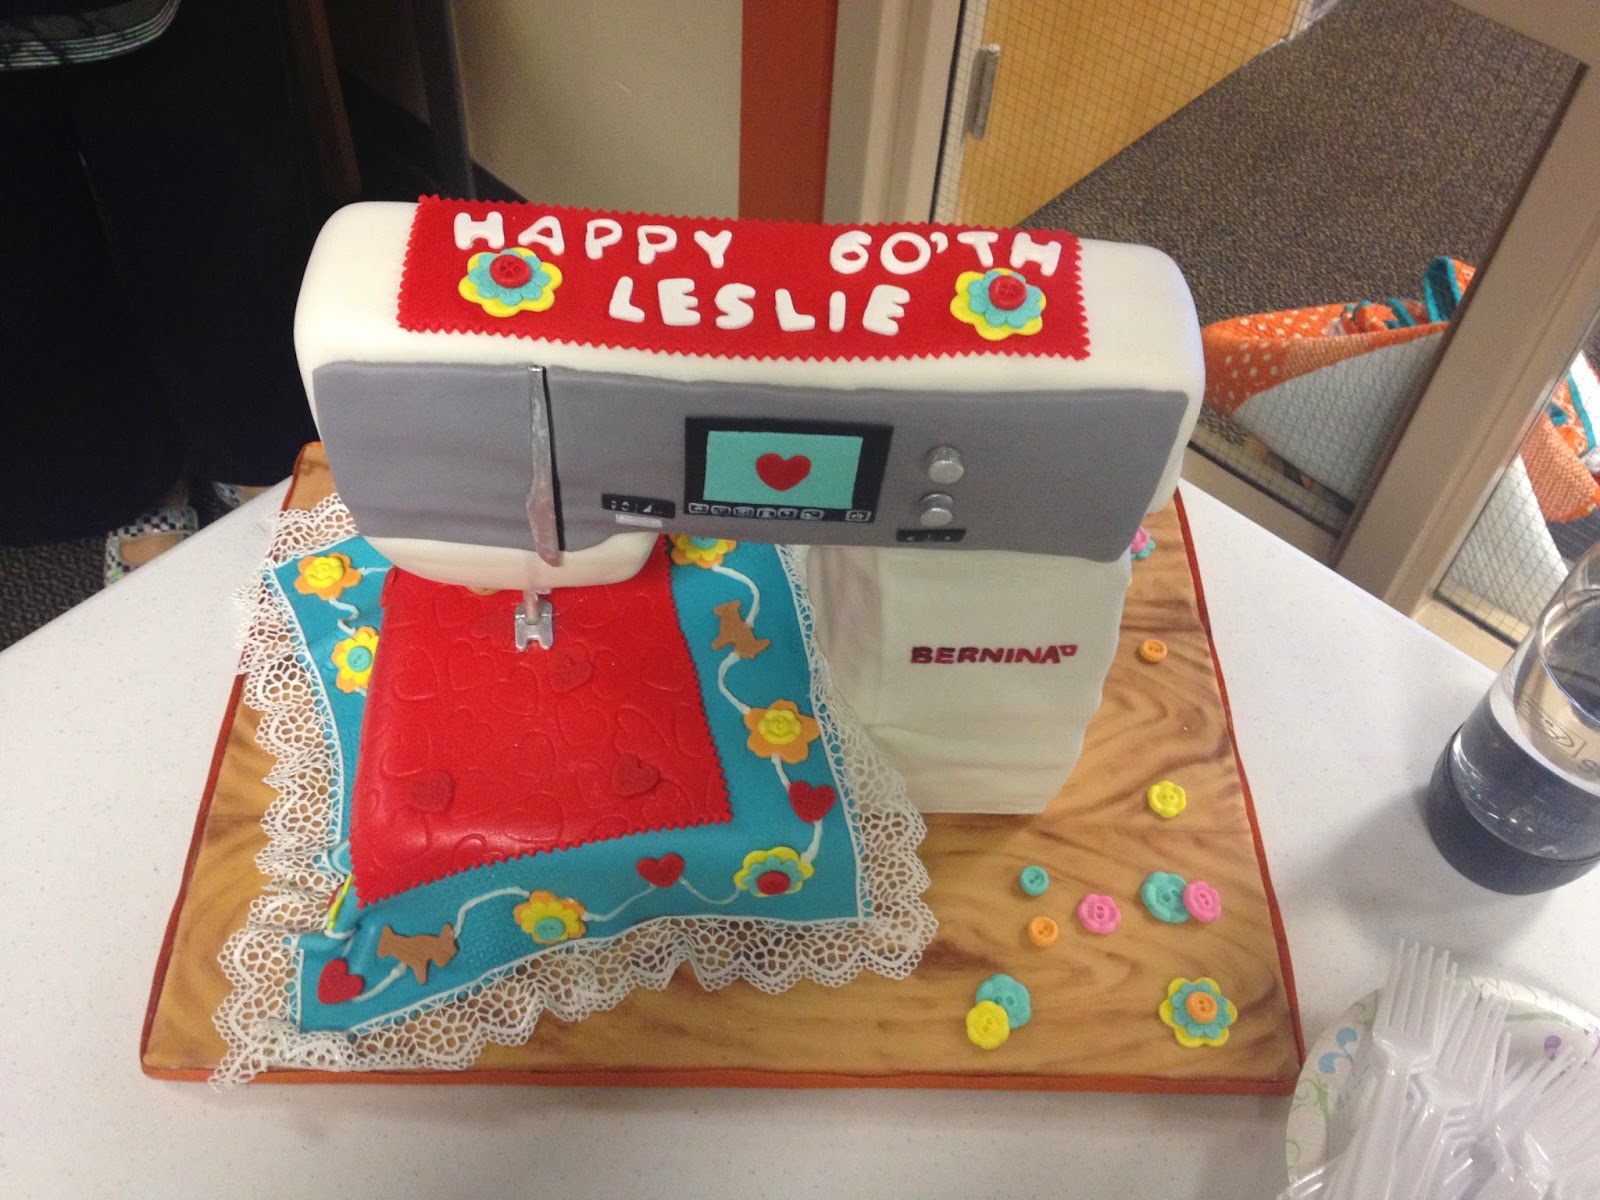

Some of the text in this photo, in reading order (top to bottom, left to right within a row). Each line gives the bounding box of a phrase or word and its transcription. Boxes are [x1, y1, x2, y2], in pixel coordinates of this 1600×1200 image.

[453, 211, 734, 269] HAPPY
[608, 276, 912, 336] LESLIE
[911, 645, 1061, 664] BERNINA
